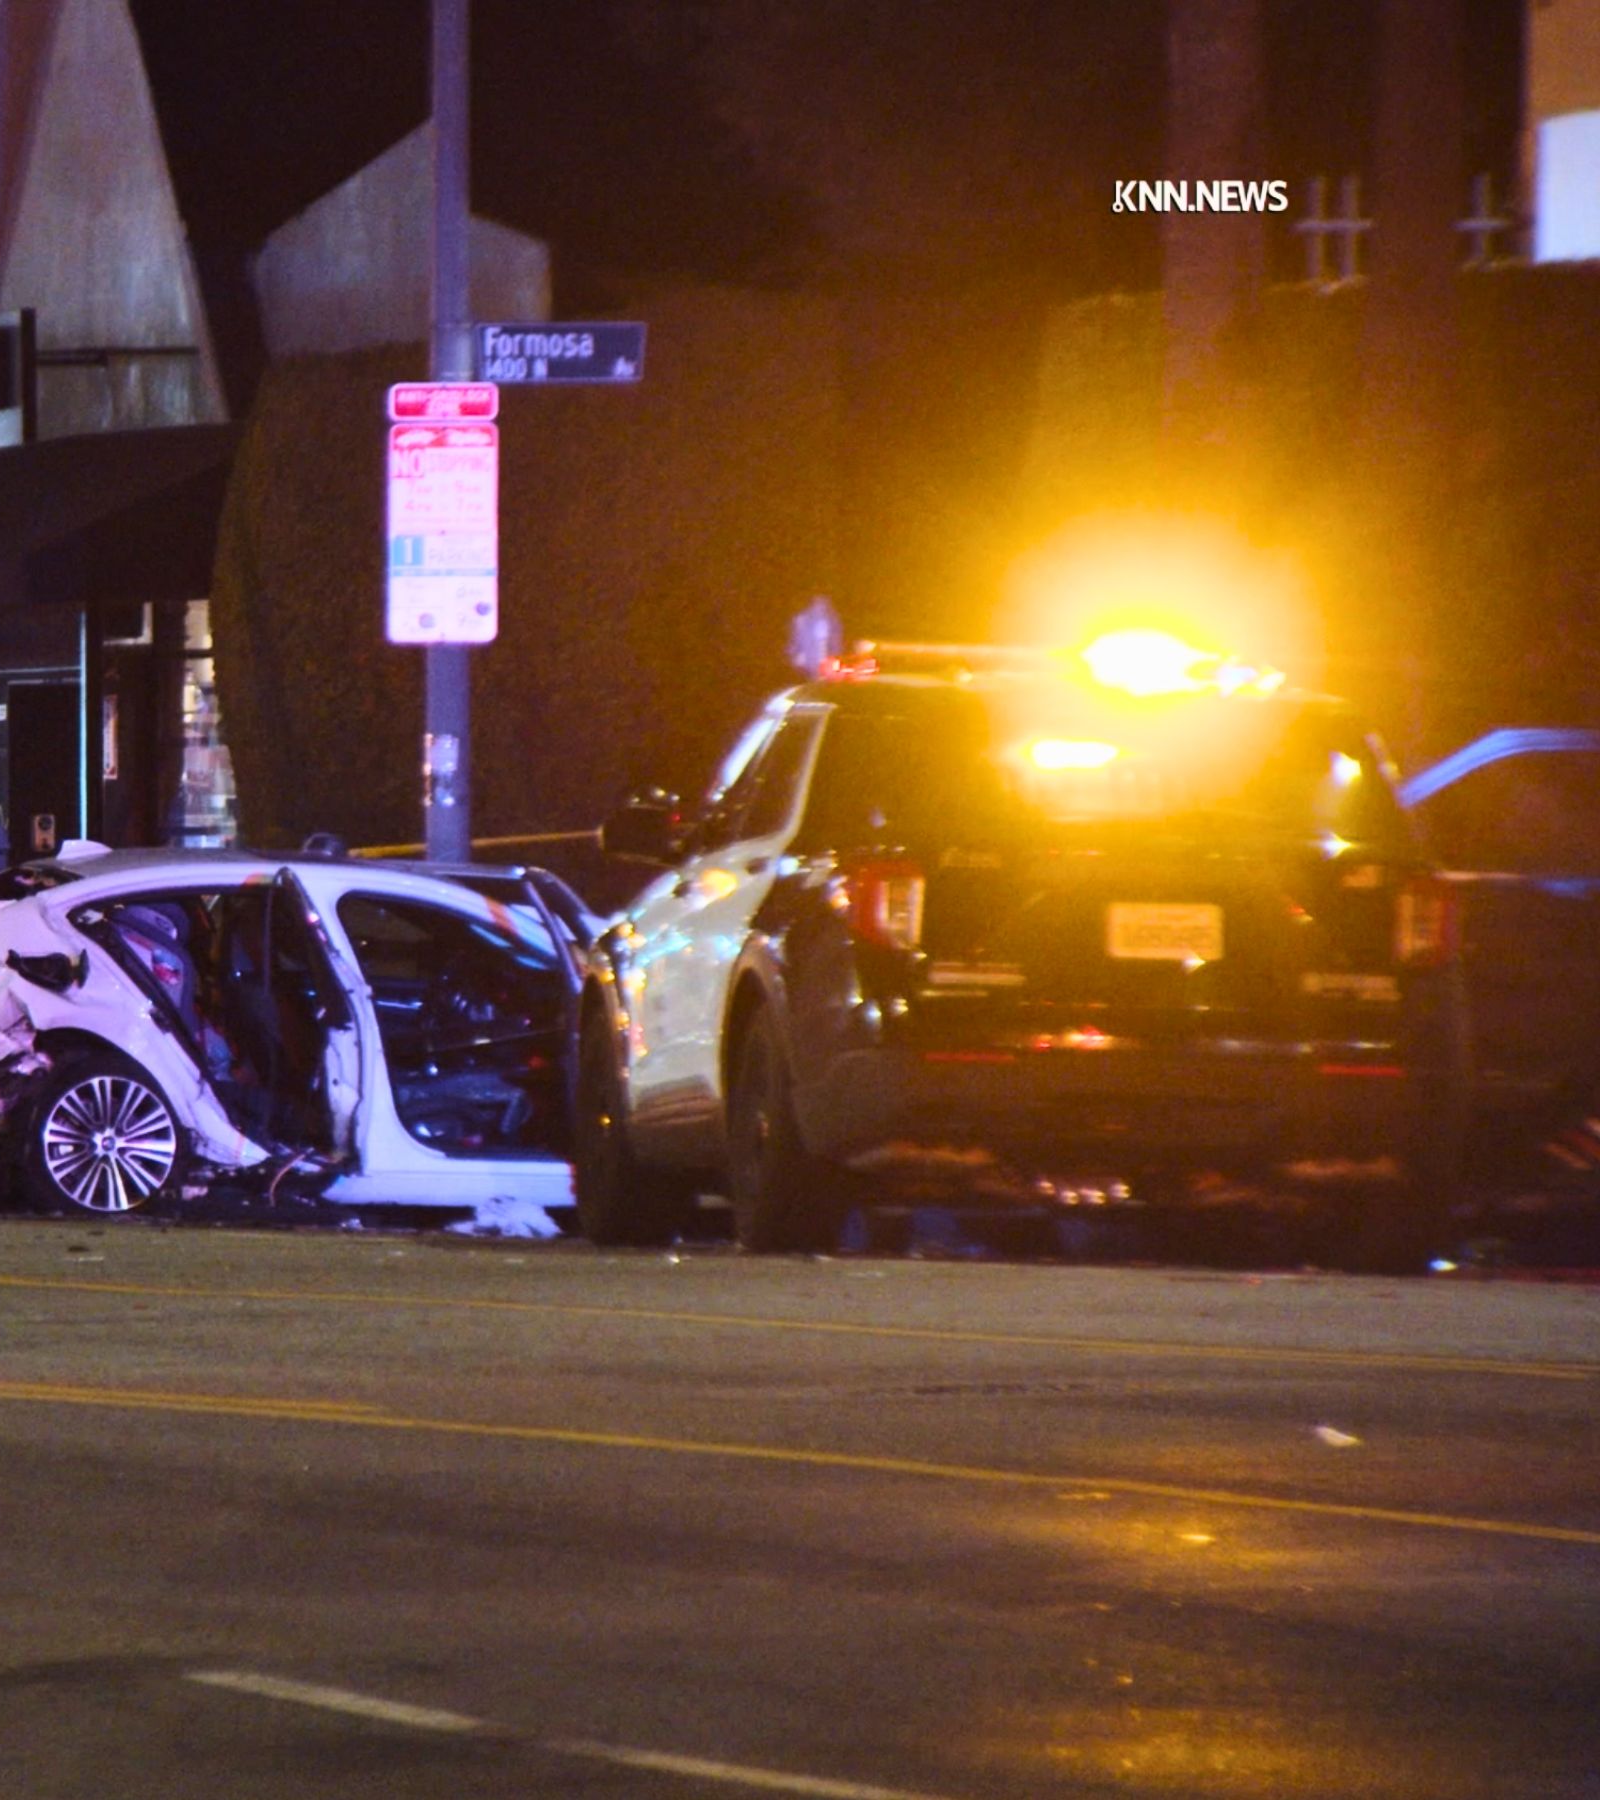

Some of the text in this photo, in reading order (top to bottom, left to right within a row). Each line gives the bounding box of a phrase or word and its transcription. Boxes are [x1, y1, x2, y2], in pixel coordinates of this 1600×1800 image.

[484, 326, 595, 358] Formosa
[485, 357, 528, 379] 1400
[392, 449, 424, 477] NO
